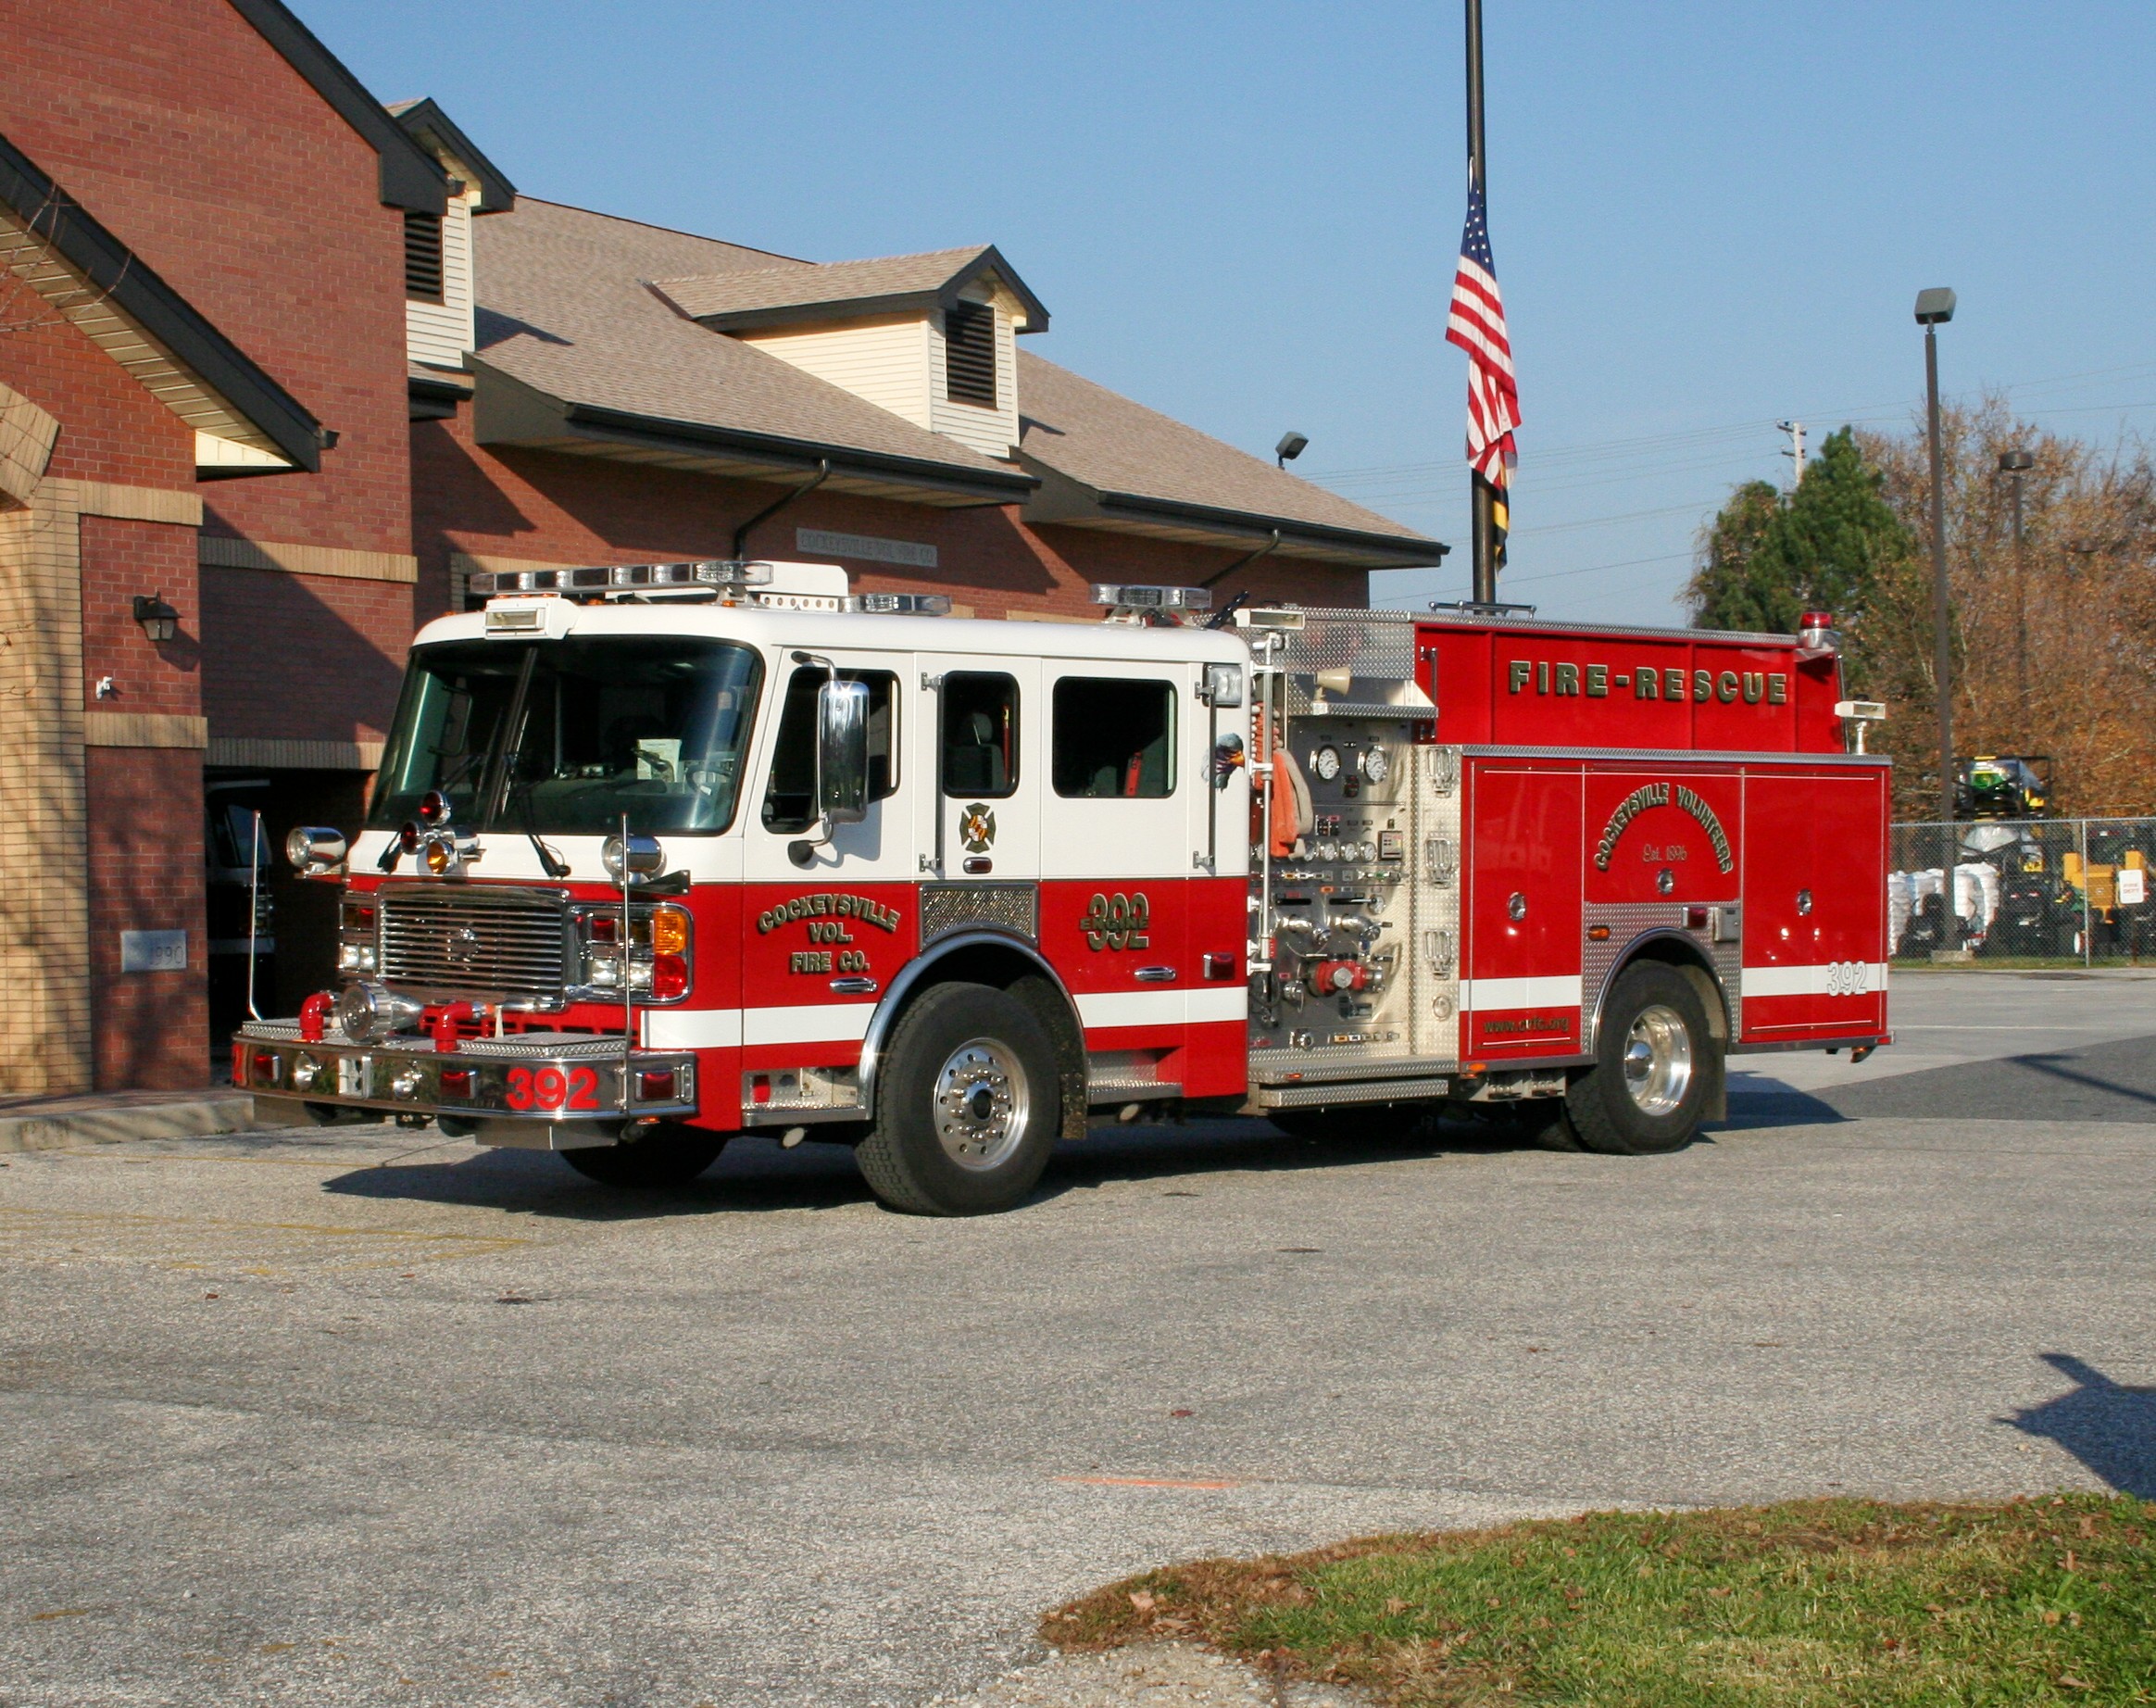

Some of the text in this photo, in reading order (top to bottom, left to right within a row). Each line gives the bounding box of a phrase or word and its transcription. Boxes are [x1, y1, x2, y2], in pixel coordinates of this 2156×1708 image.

[1509, 659, 1786, 704] FIRE-RESCUE
[1593, 782, 1734, 874] COCKEYSVILLE VOLUNTEERS
[758, 893, 901, 934] COCKEYSVILLE
[808, 922, 854, 943] VOL.
[1080, 916, 1149, 931] ENGINE
[1087, 892, 1149, 951] 392
[790, 949, 871, 973] FIRE CO.
[1826, 960, 1867, 997] 392
[506, 1066, 600, 1111] 392
